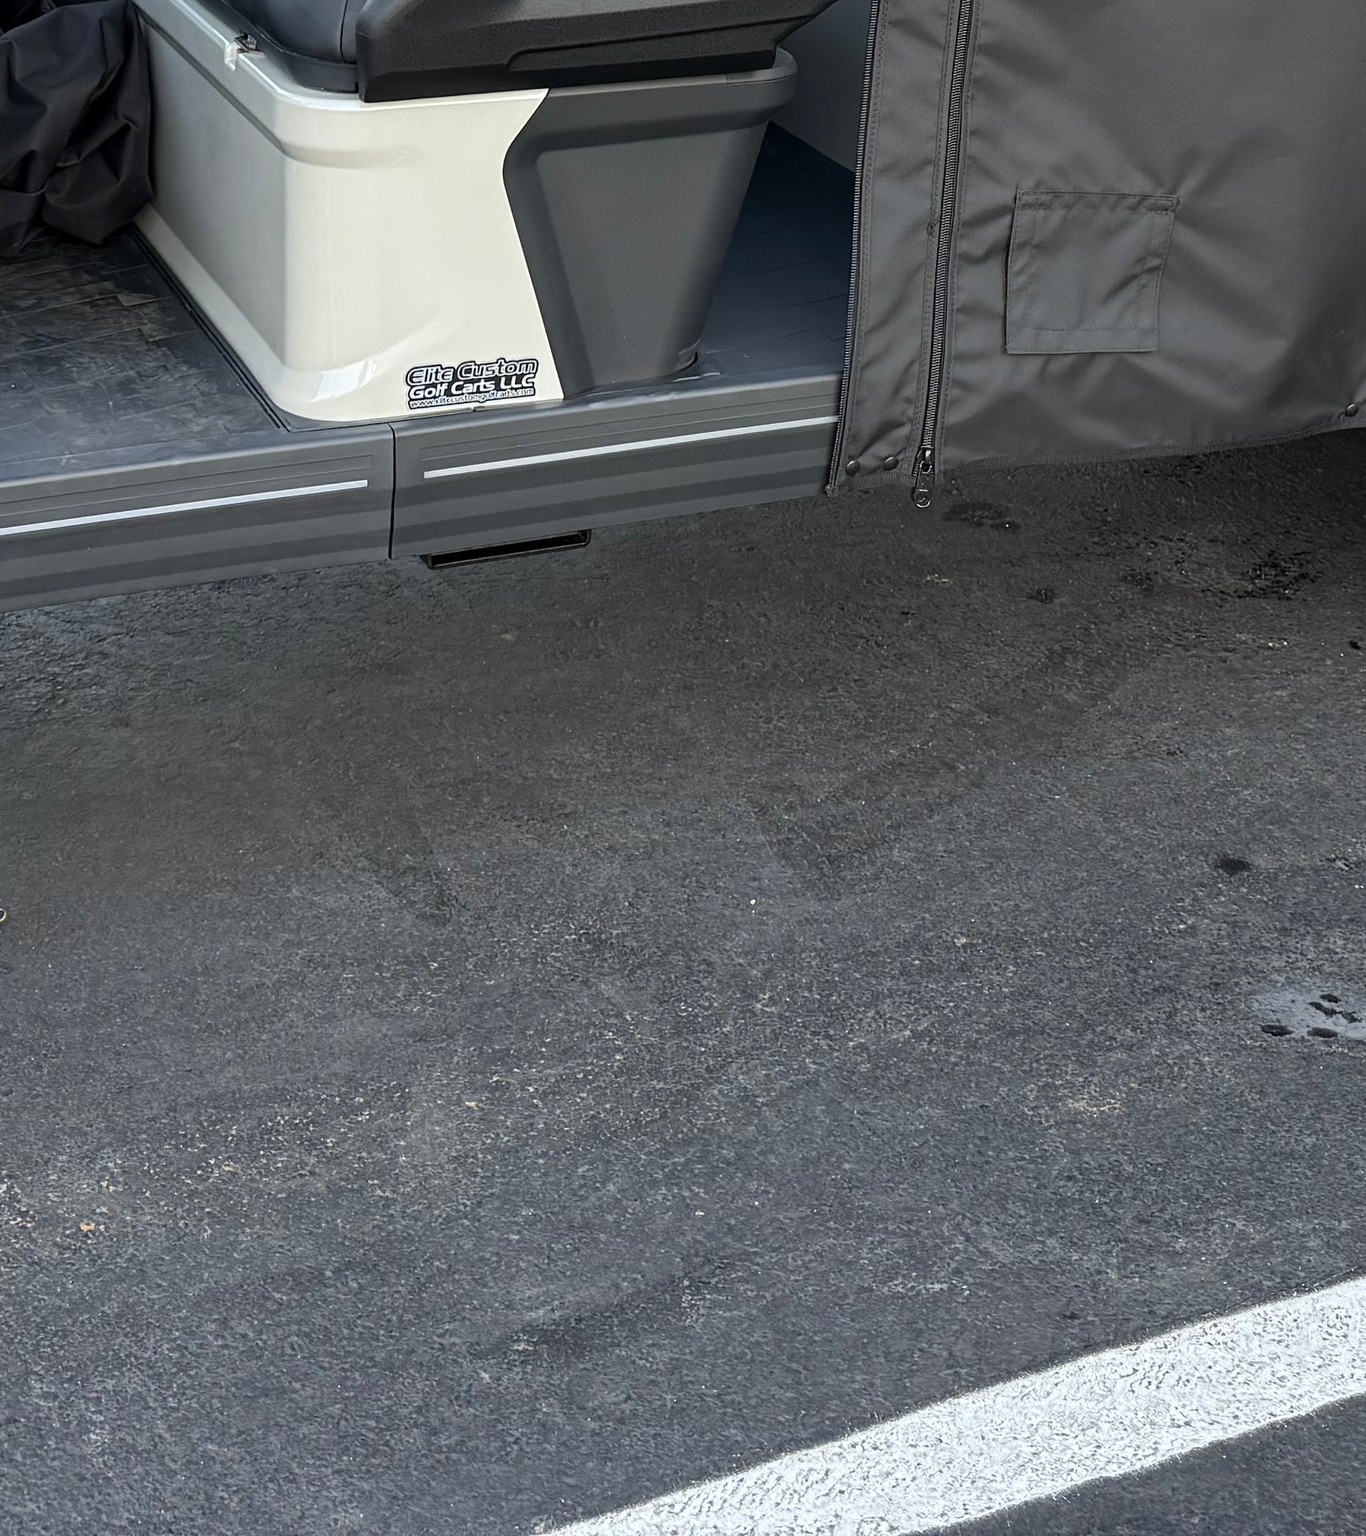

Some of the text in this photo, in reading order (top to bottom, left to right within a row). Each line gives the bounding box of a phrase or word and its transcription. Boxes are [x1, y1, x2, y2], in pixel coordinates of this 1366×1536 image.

[407, 358, 538, 387] Elite Custom
[409, 373, 535, 400] Golf Carts LLC
